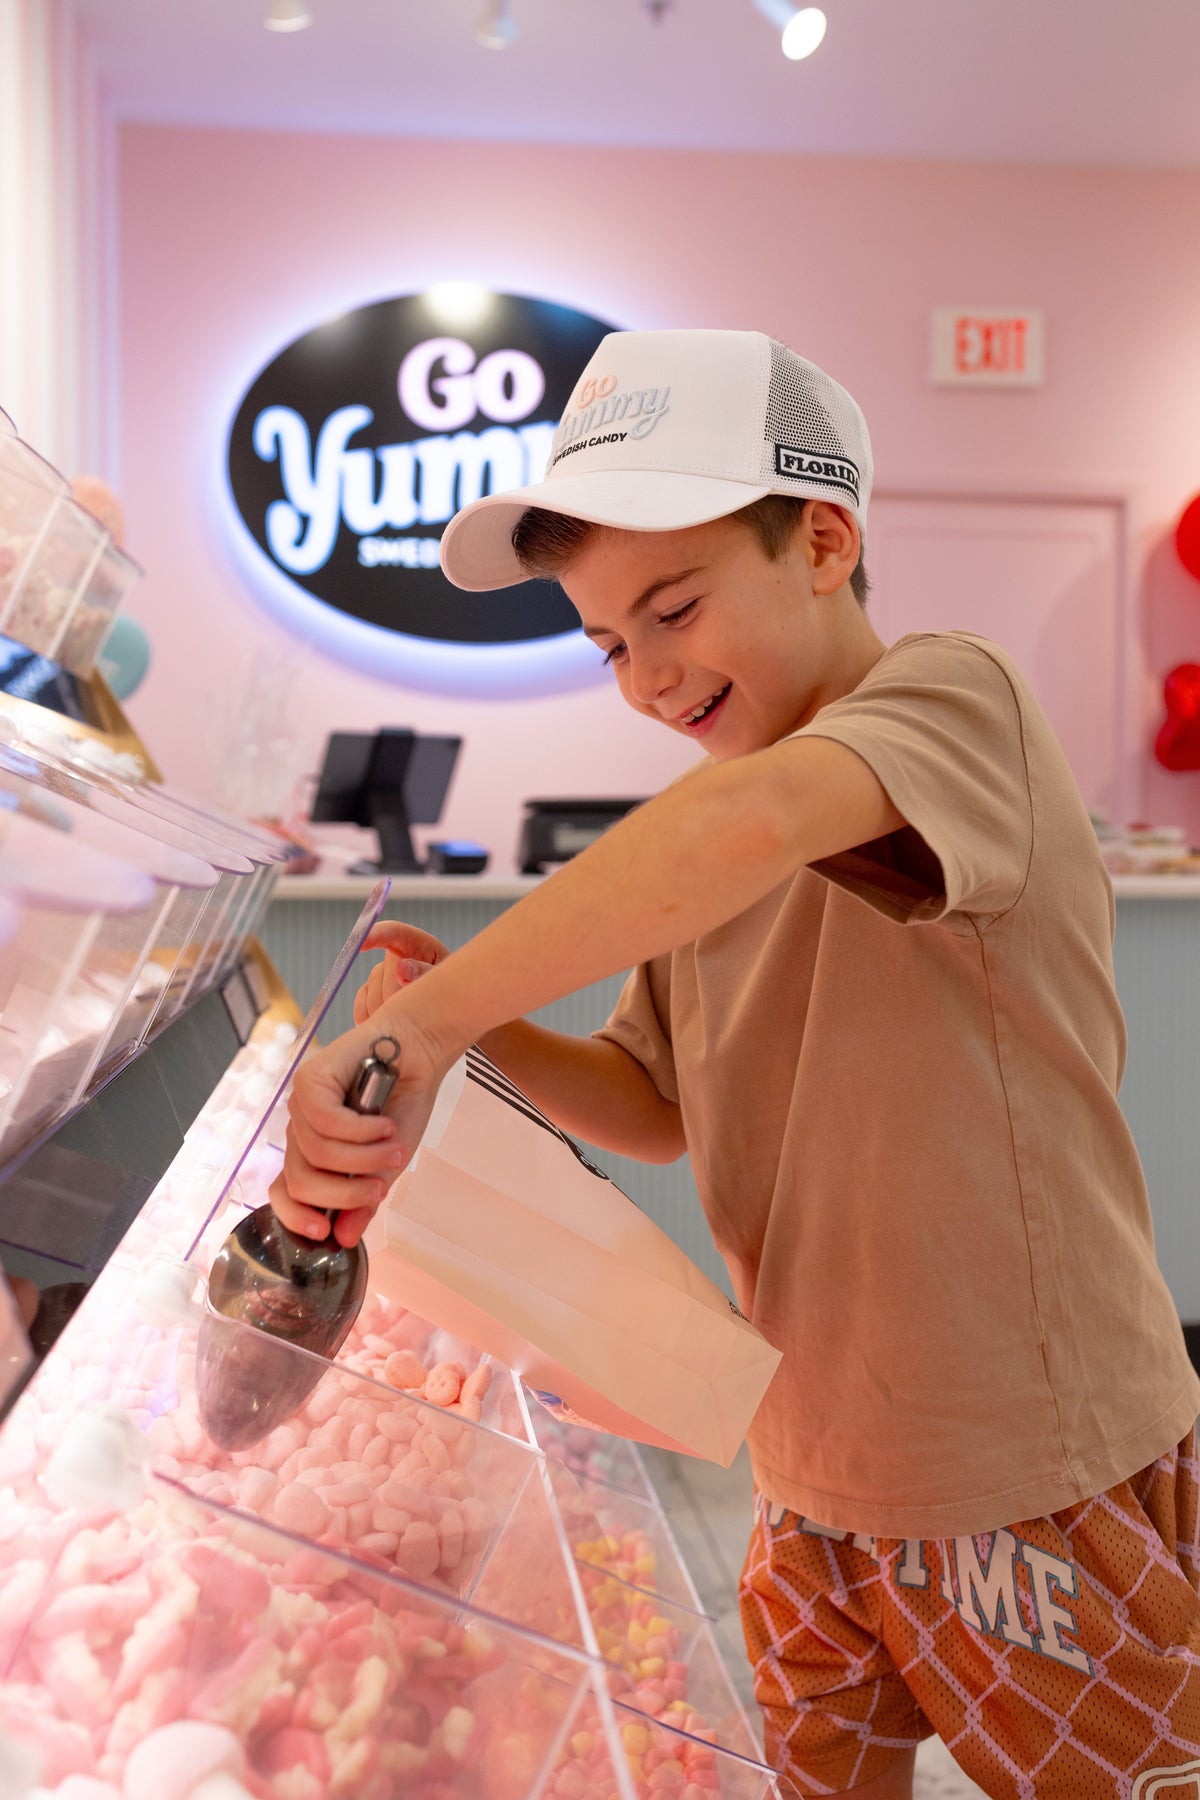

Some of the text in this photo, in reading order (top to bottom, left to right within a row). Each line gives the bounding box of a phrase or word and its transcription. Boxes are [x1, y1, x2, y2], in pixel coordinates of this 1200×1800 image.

[955, 317, 1028, 374] EXIT
[398, 337, 545, 431] Go
[553, 432, 627, 466] SWEDISH CANDY
[783, 453, 859, 490] FLORID
